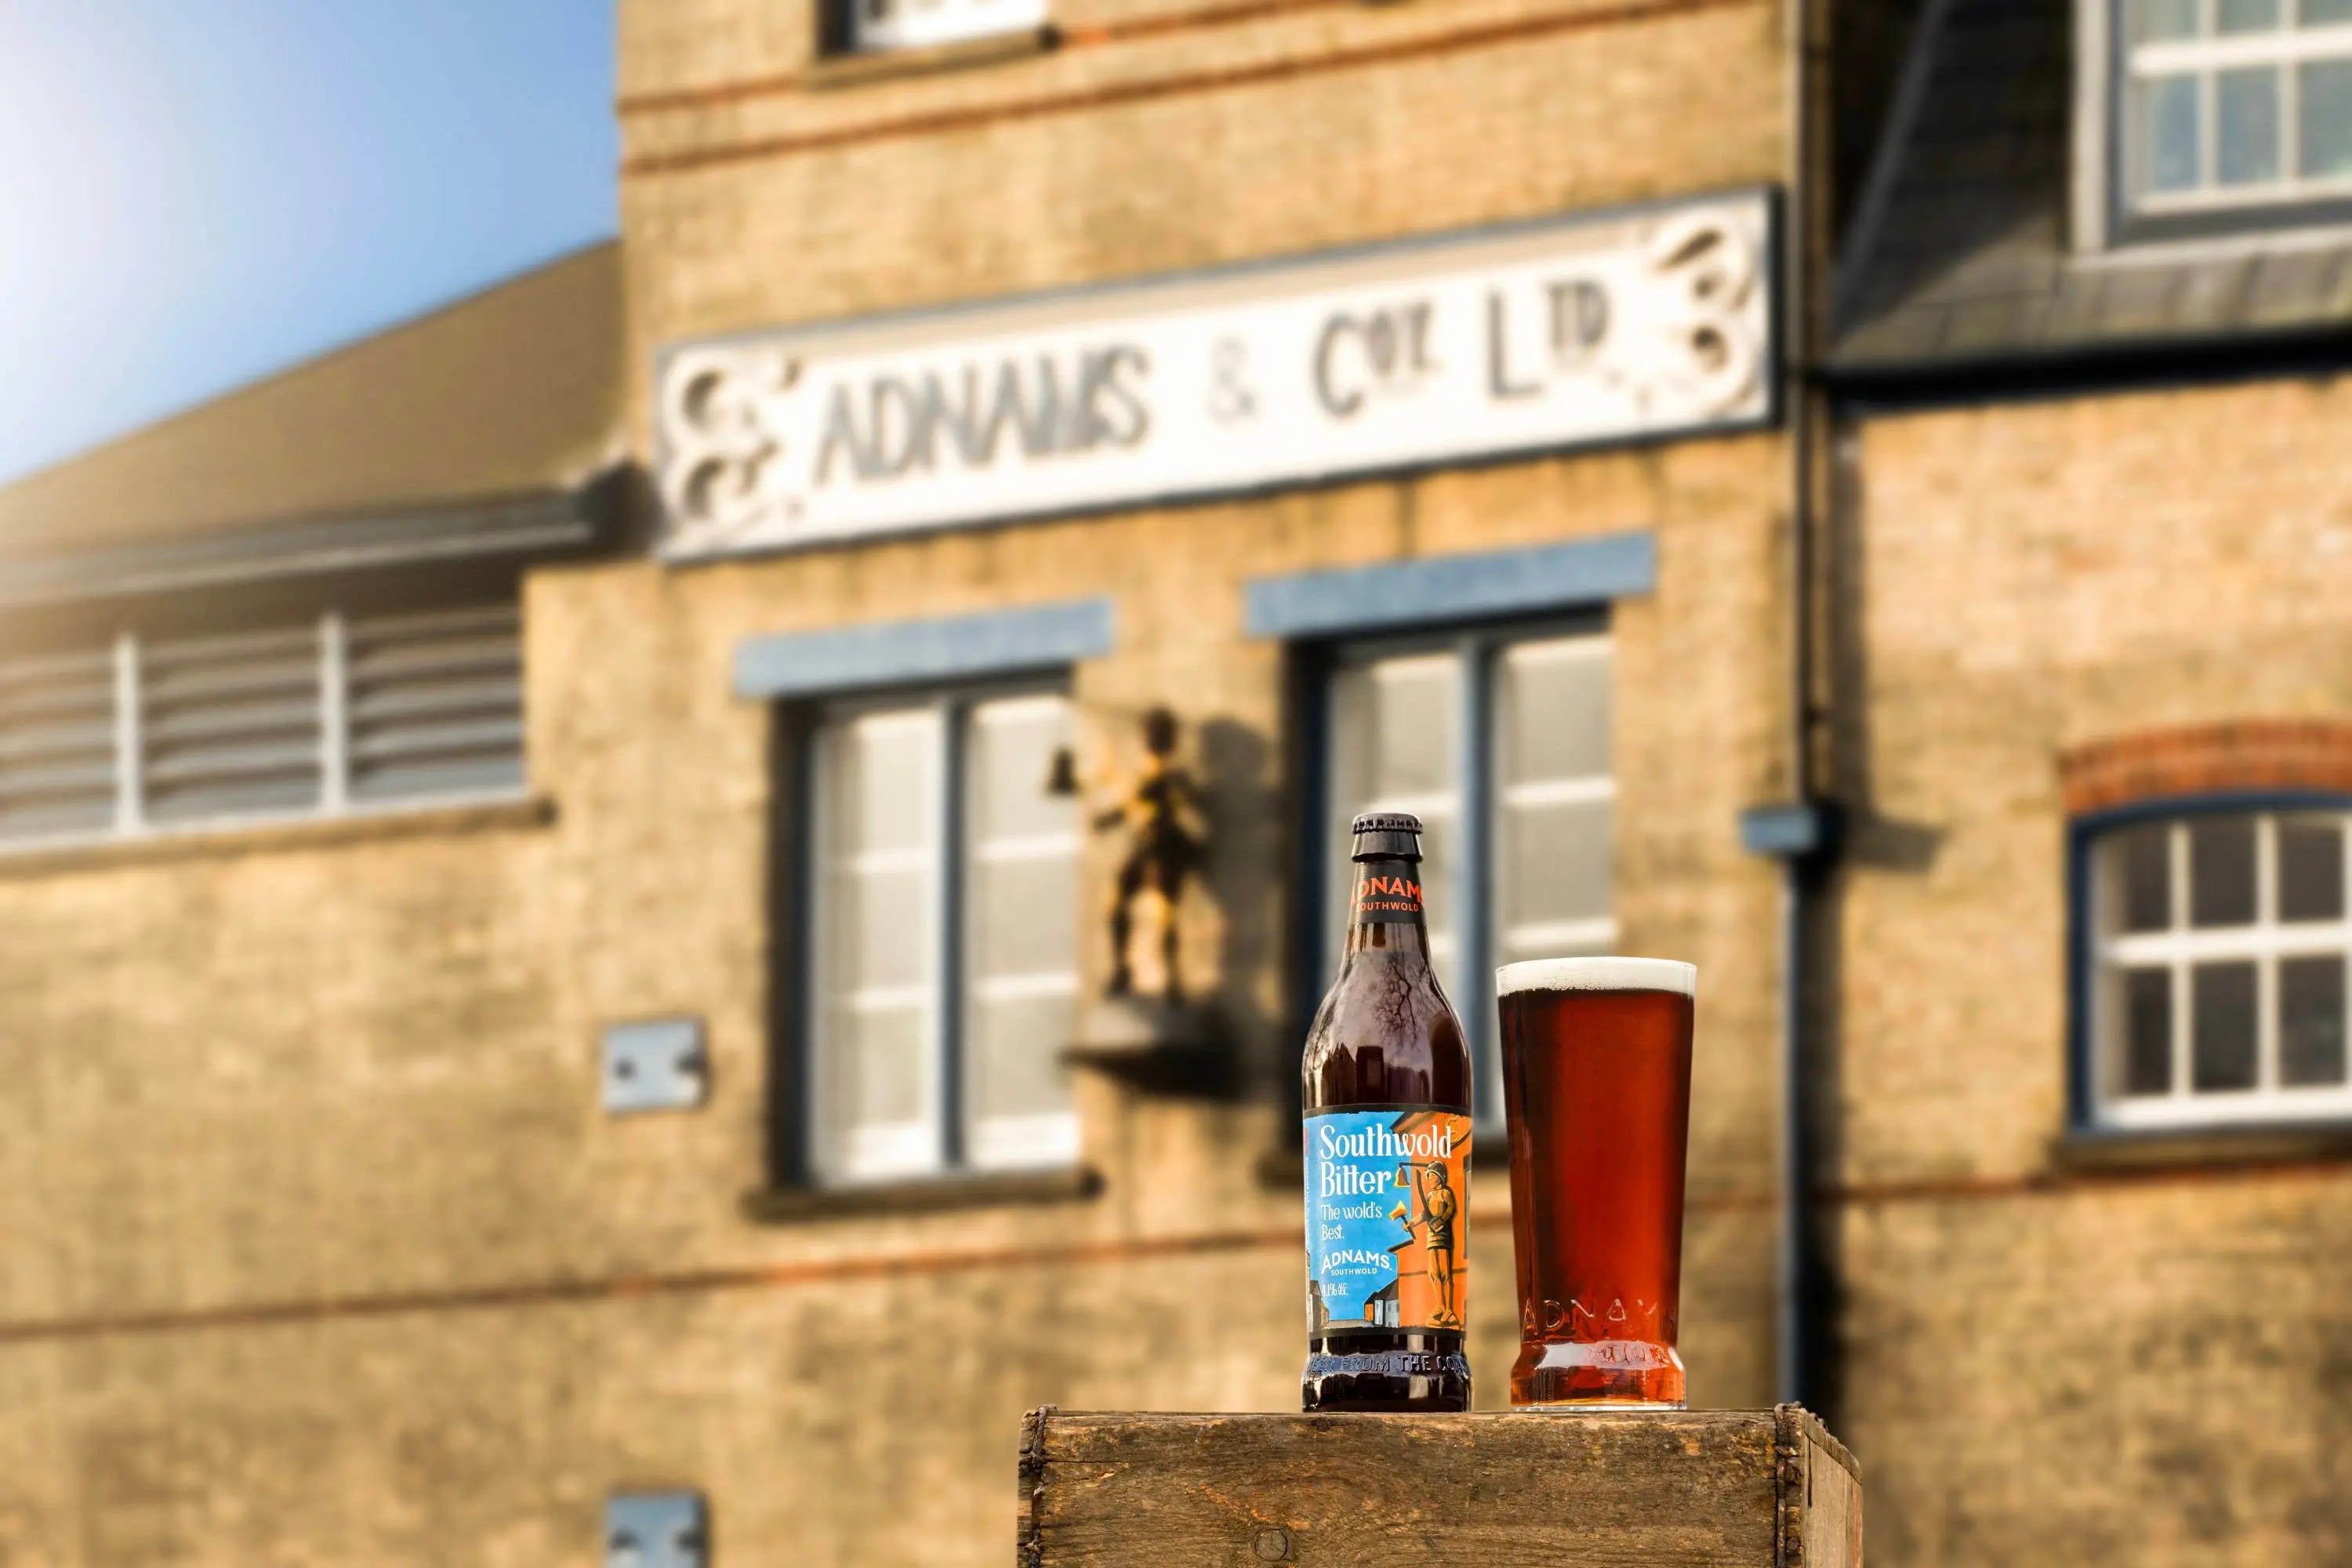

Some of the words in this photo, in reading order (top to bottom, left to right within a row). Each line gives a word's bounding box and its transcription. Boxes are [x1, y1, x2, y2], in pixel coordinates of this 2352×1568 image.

[812, 339, 1151, 486] ADNAMS
[1209, 335, 1258, 425] &
[1358, 902, 1418, 912] OUTHWOLD
[1319, 1123, 1452, 1160] Southwold
[1320, 1161, 1392, 1197] Bitter
[1320, 1203, 1341, 1221] The
[1342, 1201, 1382, 1219] wold's
[1322, 1224, 1345, 1240] Best.
[1340, 1356, 1391, 1372] FROM
[1397, 1356, 1432, 1372] THE
